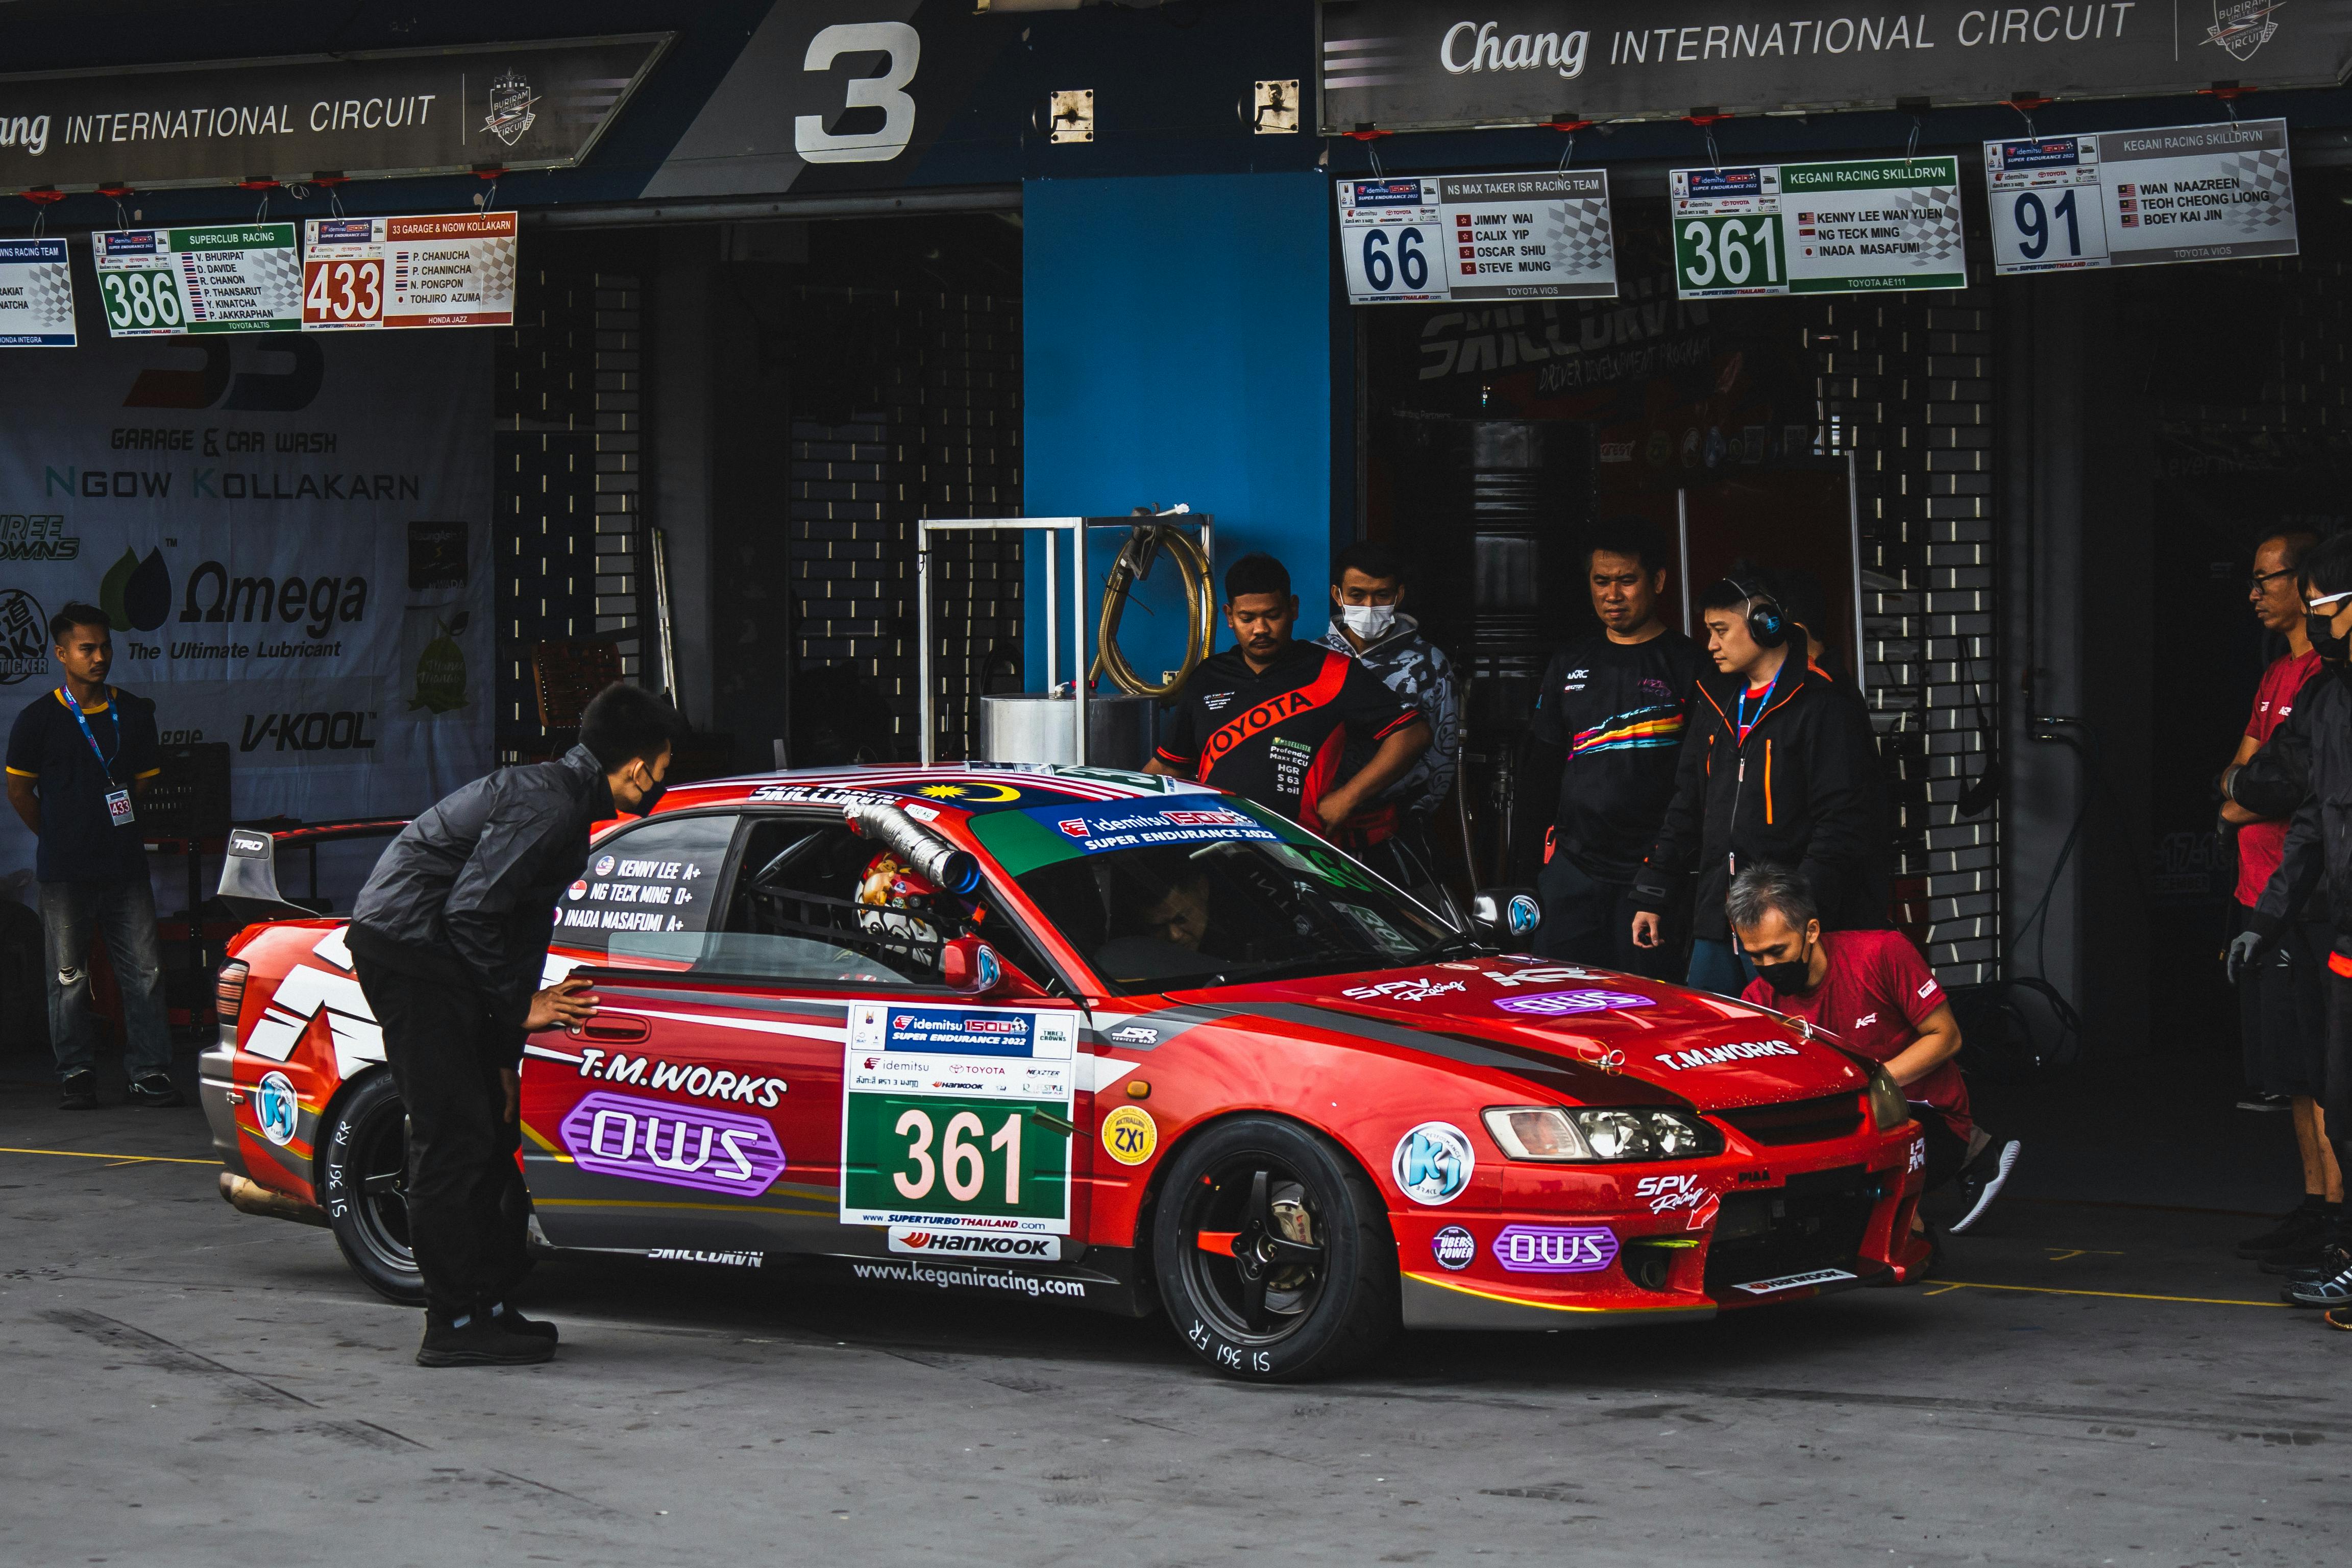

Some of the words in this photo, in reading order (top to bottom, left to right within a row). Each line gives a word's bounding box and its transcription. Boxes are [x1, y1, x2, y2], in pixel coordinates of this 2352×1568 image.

[1440, 21, 1590, 79] Chang
[1611, 14, 1934, 64] INTERNATIONAL
[1958, 3, 2136, 46] CIRCUIT
[795, 21, 920, 163] 3
[494, 90, 528, 111] BURIRAM
[65, 105, 295, 144] INTERNATIONAL
[310, 95, 436, 132] CIRCUIT
[2124, 139, 2162, 152] KEGANI
[2165, 135, 2204, 148] RACING
[2207, 130, 2263, 145] SKILLDRVN
[1791, 172, 1833, 184] KEGANI
[1836, 169, 1880, 182] RACING
[1882, 167, 1946, 180] SKILLDRVN
[1448, 185, 1460, 195] NS
[1462, 184, 1483, 194] MAX
[1484, 183, 1515, 193] TAKER
[1517, 182, 1532, 192] ISR
[1535, 181, 1571, 191] RACING
[1573, 180, 1599, 190] TEAM
[2140, 183, 2168, 195] WAN
[2174, 178, 2240, 193] NAAZREEN
[2141, 197, 2174, 210] TEOH
[2177, 193, 2229, 208] CHEONG
[2232, 190, 2270, 203] LIONG
[1474, 214, 1507, 226] JIMMY
[1512, 213, 1533, 224] WAI
[1817, 212, 1856, 224] KENNY
[1858, 211, 1880, 222] LEE
[1882, 209, 1909, 220] WAN
[1911, 208, 1943, 219] YUEN
[2144, 212, 2177, 226] BOEY
[2180, 210, 2201, 223] KAI
[2203, 209, 2222, 221] JIN
[392, 226, 401, 234] 33
[402, 224, 433, 234] GARAGE
[435, 224, 440, 233] &
[442, 223, 466, 233] NGOW
[467, 220, 511, 231] KOLLAKARN
[2014, 189, 2081, 260] 91
[189, 234, 239, 244] SUPERCLUB
[242, 232, 275, 242] RACING
[1475, 230, 1508, 241] CALIX
[1512, 230, 1530, 240] YIP
[1819, 230, 1835, 240] NG
[1837, 228, 1868, 239] TECK
[1871, 227, 1900, 238] MING
[15, 247, 40, 256] RACING
[40, 247, 59, 256] TEAM
[195, 253, 204, 262] V.
[205, 251, 244, 261] BHURIPAT
[413, 253, 420, 261] P.
[422, 251, 470, 260] CHANUCHA
[1477, 247, 1515, 257] OSCAR
[1521, 245, 1546, 256] SHIU
[1684, 217, 1777, 285] 361
[1819, 245, 1855, 257] INADA
[1860, 242, 1920, 255] MASAFUMI
[2174, 248, 2209, 258] TOYOTA
[2211, 247, 2232, 256] VIOS
[1363, 227, 1428, 291] 66
[1479, 262, 1513, 273] STEVE
[1518, 261, 1551, 272] MUNG
[197, 265, 206, 274] D.
[207, 264, 237, 273] DAVIDE
[412, 266, 419, 276] P.
[422, 265, 472, 275] CHANINCHA
[200, 277, 209, 285] R.
[210, 276, 246, 284] CHANON
[410, 281, 419, 289] N.
[421, 279, 463, 289] PONGPON
[1848, 279, 1882, 287] TOYOTA
[204, 288, 212, 297] P.
[212, 286, 262, 297] THANSARUT
[306, 262, 381, 320] 433
[410, 293, 447, 304] TOHJIRO
[451, 292, 481, 303] AZUMA
[1506, 287, 1540, 296] TOYOTA
[105, 273, 180, 327] 386
[206, 300, 214, 309] Y.
[215, 299, 257, 308] KINATCHA
[209, 311, 217, 320] P.
[218, 309, 274, 320] JAKKRAPHAN
[111, 429, 195, 451] GARAGE
[203, 428, 221, 457] &
[226, 431, 265, 452] CAR
[276, 433, 338, 454] WASH
[45, 465, 172, 498] NGOW
[192, 468, 420, 501] KOLLAKARN
[129, 642, 161, 660] The
[170, 642, 250, 659] Ultimate
[257, 641, 341, 658] Lubricant
[240, 712, 377, 752] V-KOOL
[1269, 753, 1290, 762] Maxx
[1292, 757, 1308, 767] ECU
[1270, 746, 1310, 760] Profender
[1278, 764, 1300, 775] HGR
[1287, 776, 1300, 785] 63
[112, 800, 130, 815] 433
[1087, 816, 1170, 832] idemitsu
[234, 839, 263, 851] TRD
[1084, 834, 1138, 851] SUPER
[1144, 829, 1242, 843] ENDURANCE
[1244, 829, 1278, 839] 2022
[617, 860, 657, 878] KENNY
[657, 862, 682, 879] LEE
[682, 863, 701, 880] A+
[590, 883, 610, 900] NG
[610, 884, 638, 902] TECK
[639, 886, 672, 904] MING
[564, 909, 600, 928] INADA
[601, 911, 664, 932] MASAFUMI
[666, 915, 684, 932] A+
[1342, 978, 1430, 1000] SPV
[1394, 980, 1464, 1002] Racing
[913, 1018, 963, 1032] idemitsu
[892, 1032, 927, 1042] SUPER
[929, 1033, 1000, 1045] ENDURANCE
[1001, 1037, 1026, 1046] 2022
[1654, 1039, 1800, 1072] T.M.WORKS
[883, 1061, 929, 1072] idemitsu
[966, 1066, 1006, 1075] TOYOTA
[578, 1048, 787, 1108] T.M.WORKS
[591, 1110, 758, 1182] OWS
[1115, 1128, 1144, 1153] ZX1
[893, 1109, 1022, 1205] 361
[1635, 1174, 1698, 1196] SPV
[1649, 1187, 1709, 1215] Racing
[1438, 1247, 1474, 1259] POWER
[1510, 1234, 1604, 1264] OWS
[853, 1261, 1085, 1297] www.keganiracing.com
